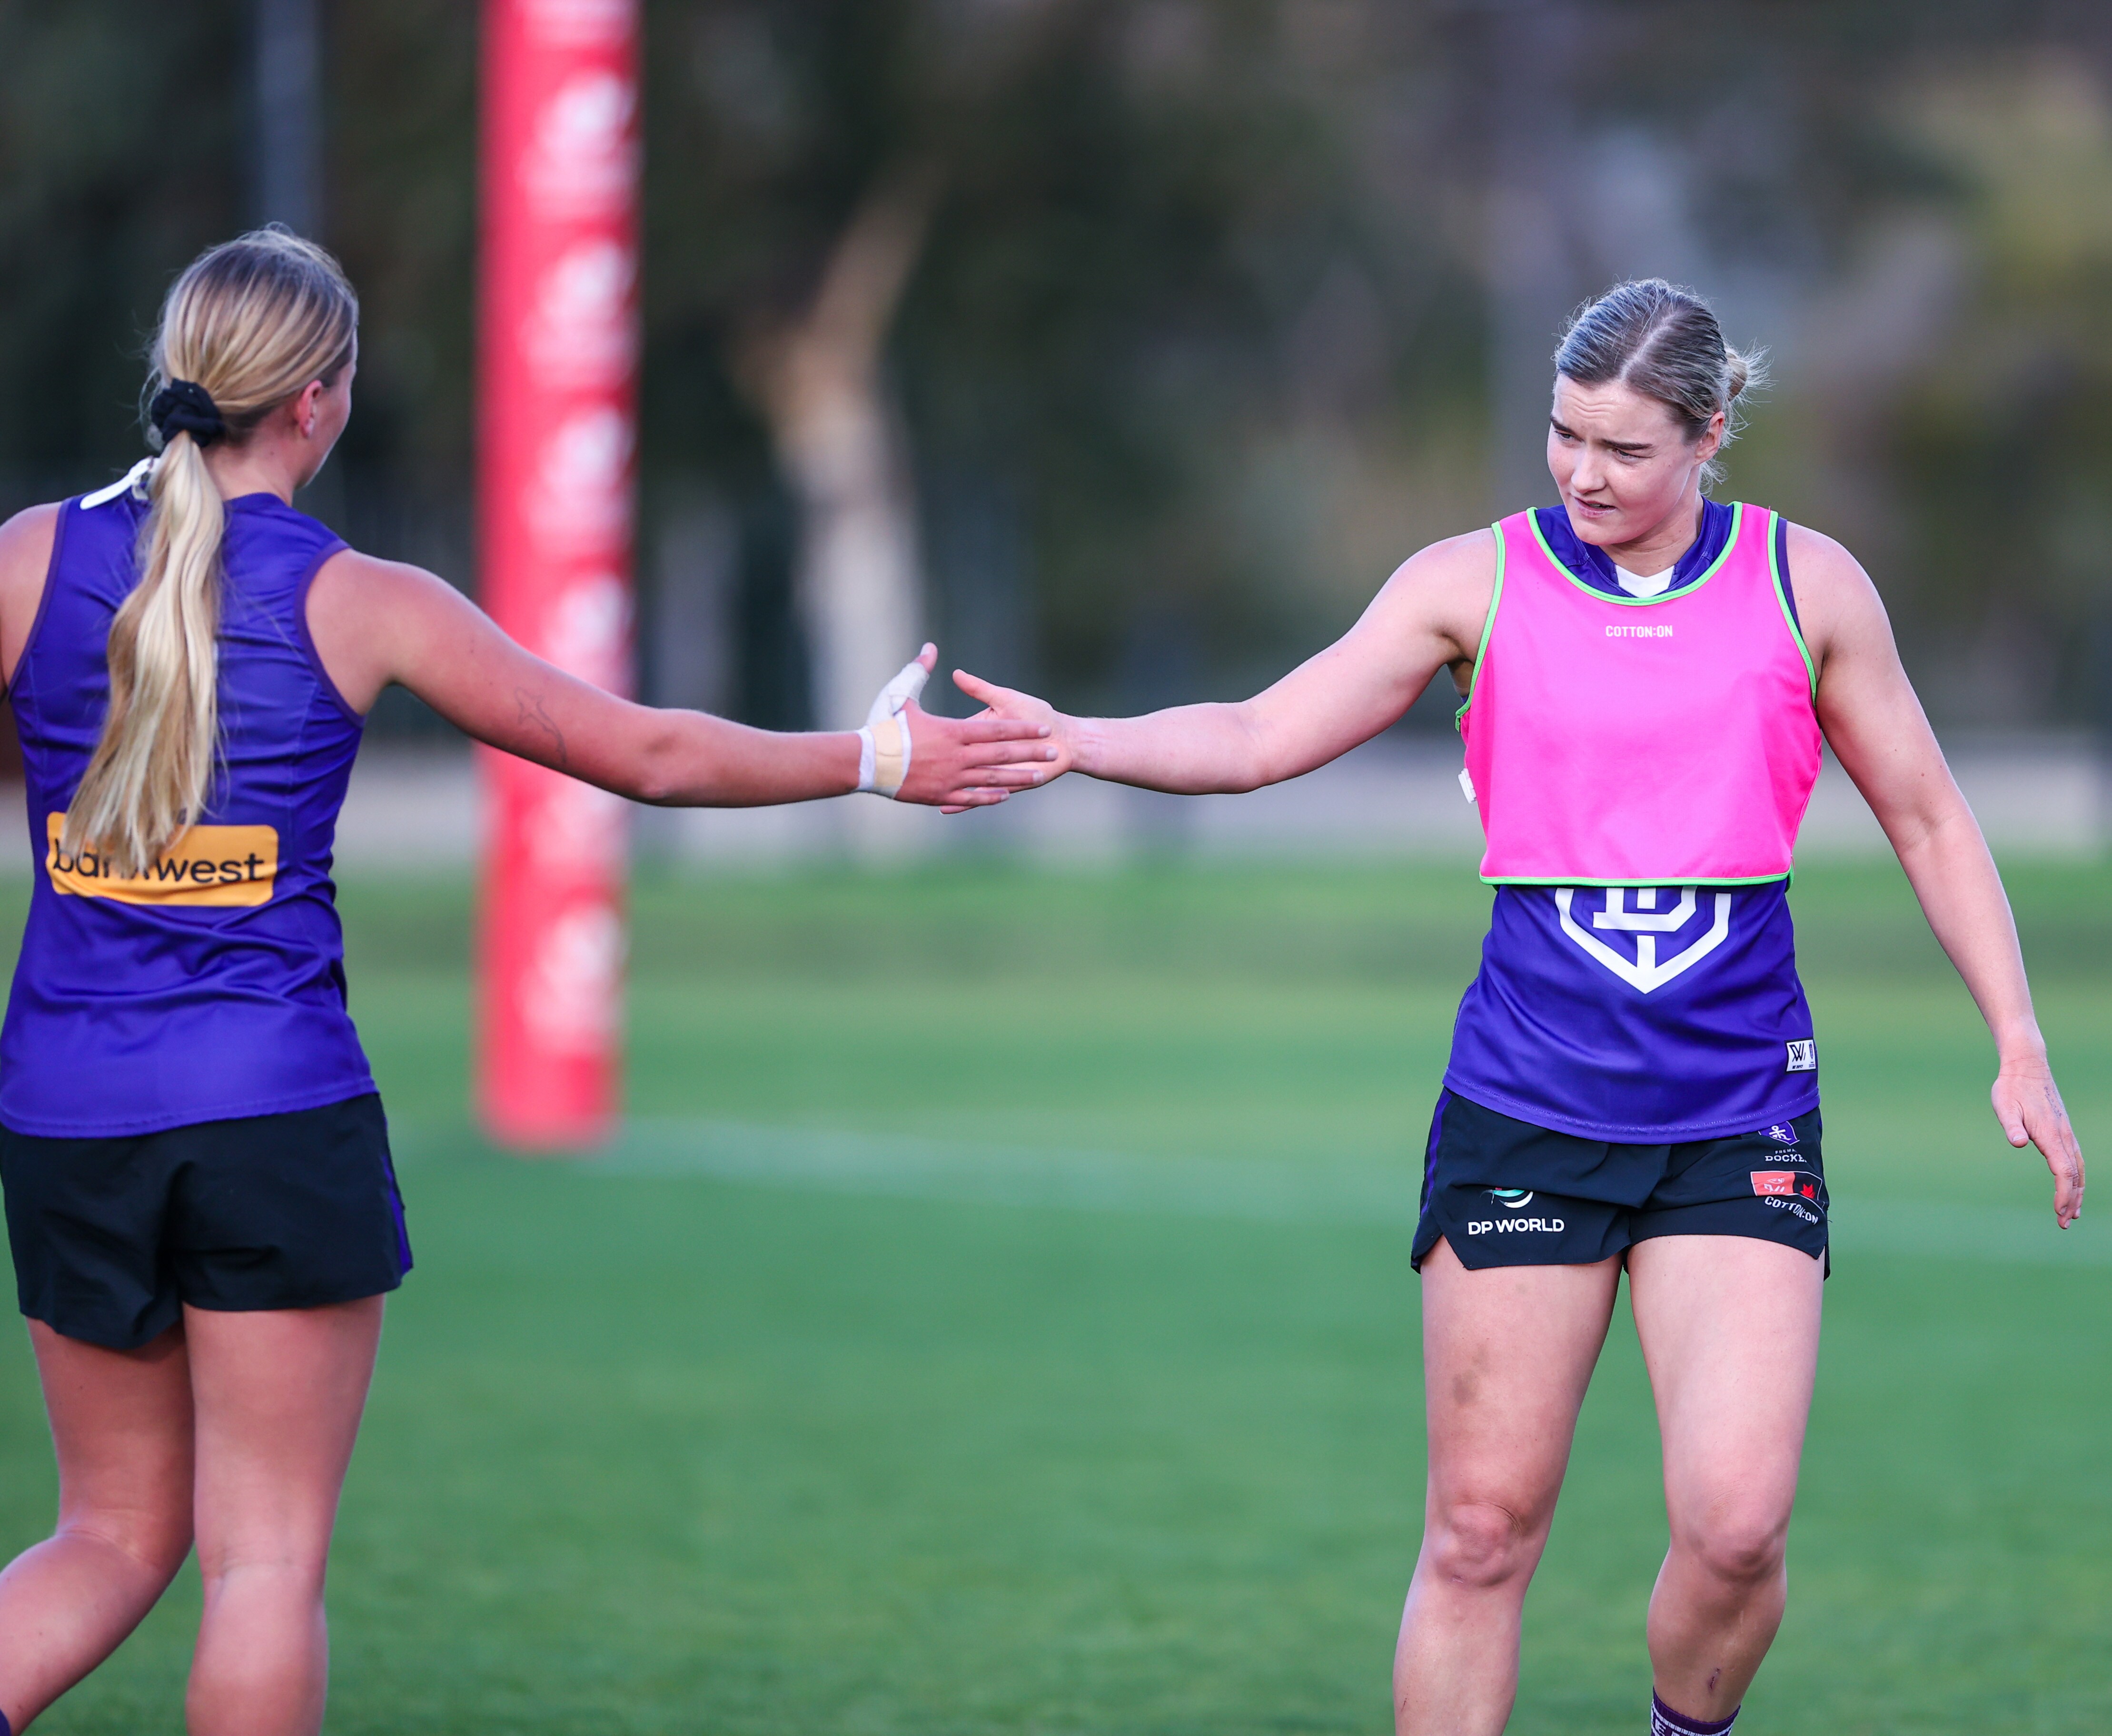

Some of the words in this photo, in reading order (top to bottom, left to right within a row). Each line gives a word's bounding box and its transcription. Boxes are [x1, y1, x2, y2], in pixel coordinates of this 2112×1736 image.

[1606, 625, 1673, 638] COTTON:ON
[1765, 1154, 1807, 1163] DOCKE
[1765, 1196, 1818, 1225] COTTON:ON
[1468, 1221, 1493, 1235] DP
[1496, 1218, 1565, 1233] WORLD
